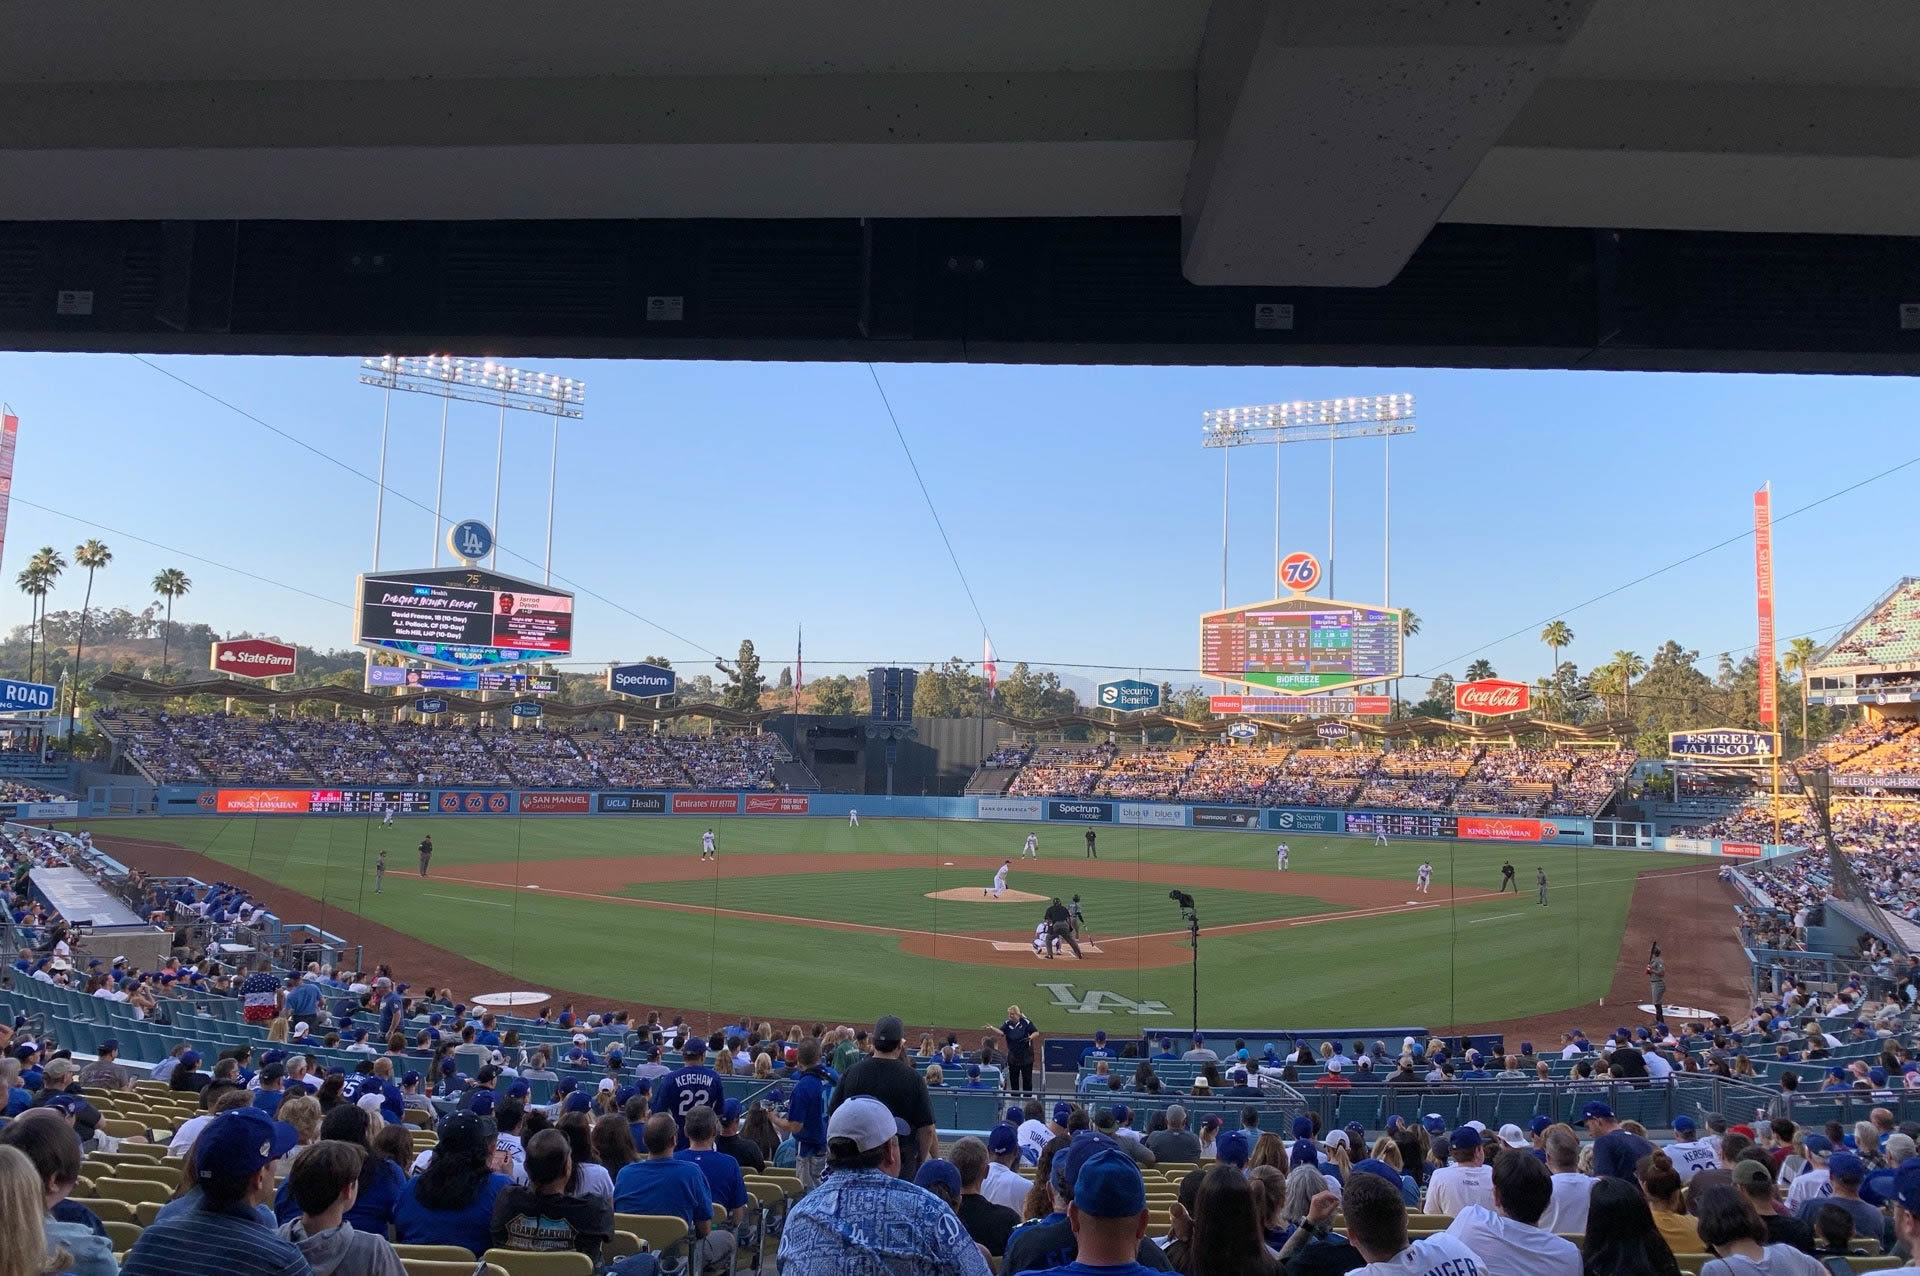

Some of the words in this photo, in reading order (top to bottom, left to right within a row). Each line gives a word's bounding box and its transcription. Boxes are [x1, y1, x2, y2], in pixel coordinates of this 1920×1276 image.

[463, 526, 482, 554] LA
[1286, 559, 1314, 582] 76
[1759, 548, 1769, 599] Emirates
[616, 673, 667, 686] Spectrum
[1121, 686, 1154, 697] Security
[1760, 660, 1772, 712] Emirates
[6, 685, 48, 706] ROAD
[1340, 703, 1345, 712] 2
[1348, 703, 1353, 712] 0
[1680, 745, 1749, 754] JALISCO
[1849, 778, 1874, 786] LEXUS
[200, 795, 215, 807] 76
[257, 801, 298, 809] HAWAIIAN
[443, 796, 457, 807] 76
[468, 796, 482, 807] 76
[492, 796, 505, 807] 76
[607, 799, 626, 807] UCLA
[631, 799, 660, 808] Health
[1060, 804, 1099, 814] Spectrum
[1296, 813, 1326, 822] Security
[1543, 827, 1555, 835] 76
[1034, 983, 1175, 1016] LA
[675, 1074, 714, 1088] KERSHAW
